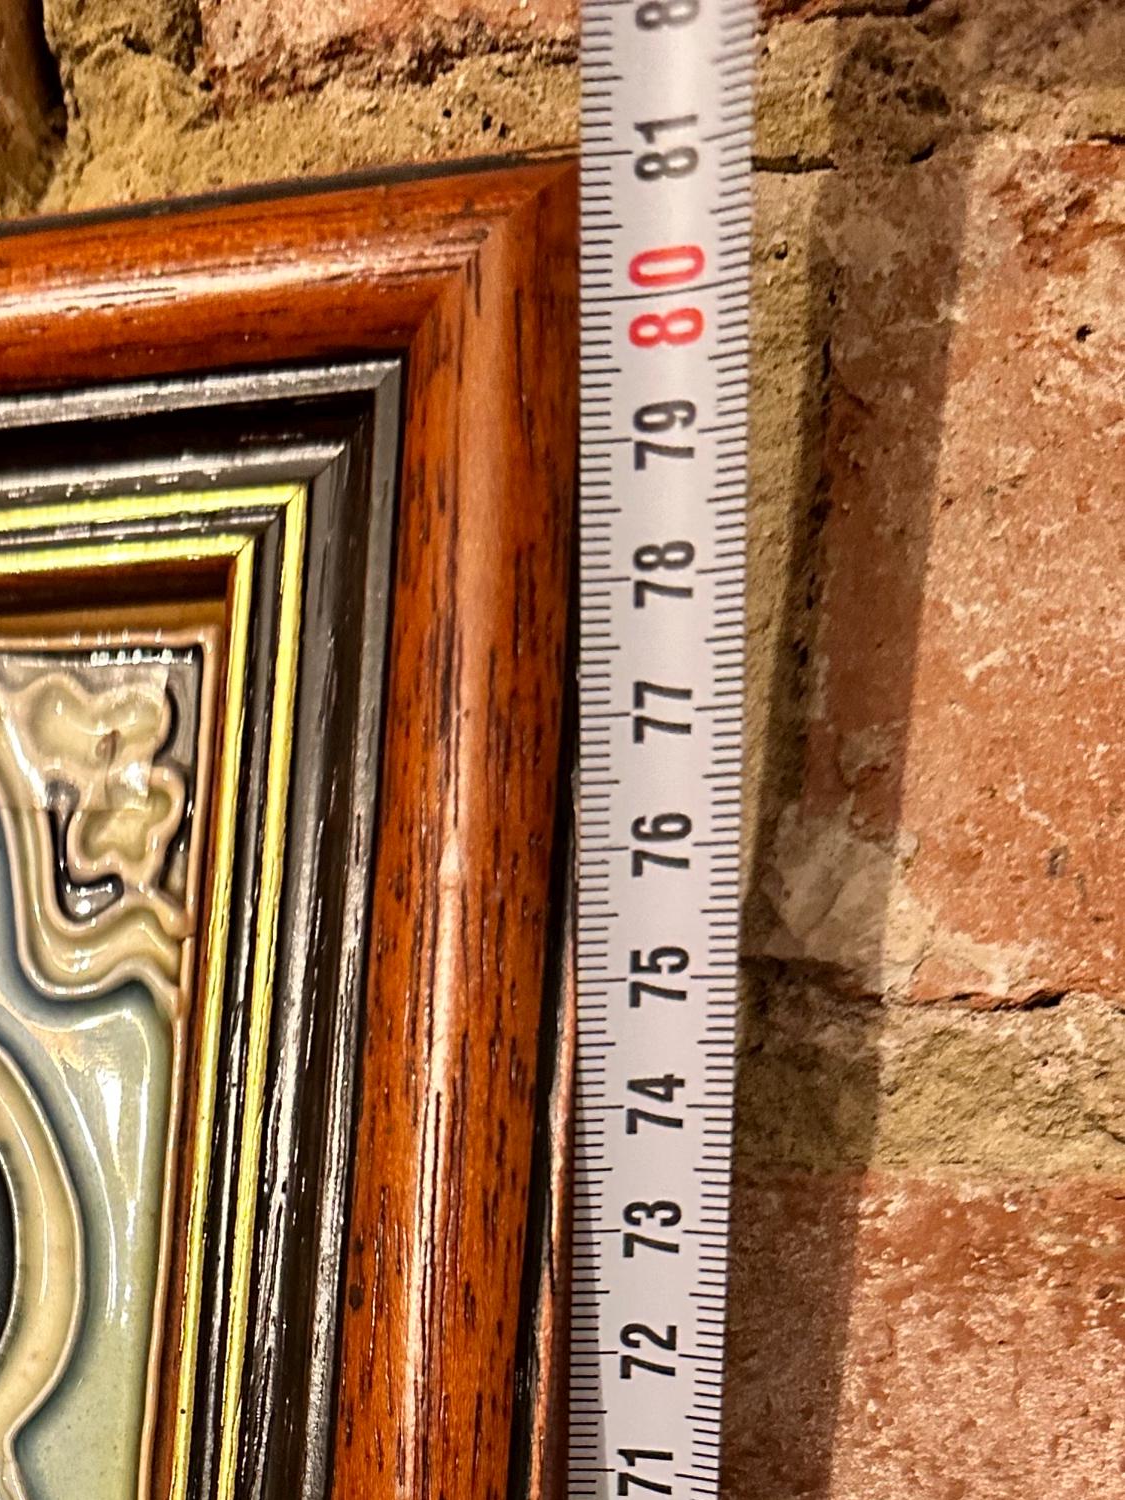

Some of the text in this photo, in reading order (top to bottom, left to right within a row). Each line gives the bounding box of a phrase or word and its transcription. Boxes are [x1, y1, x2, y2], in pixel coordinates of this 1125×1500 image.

[633, 0, 697, 31] 8
[633, 113, 698, 180] 81
[627, 244, 706, 348] 80
[633, 398, 695, 472] 79
[633, 539, 695, 609] 78
[632, 680, 692, 744] 77
[630, 811, 692, 878] 76
[629, 944, 690, 1009] 75
[626, 1074, 686, 1134] 74
[623, 1199, 683, 1258] 73
[619, 1324, 677, 1380] 72
[617, 1449, 674, 1497] 71
